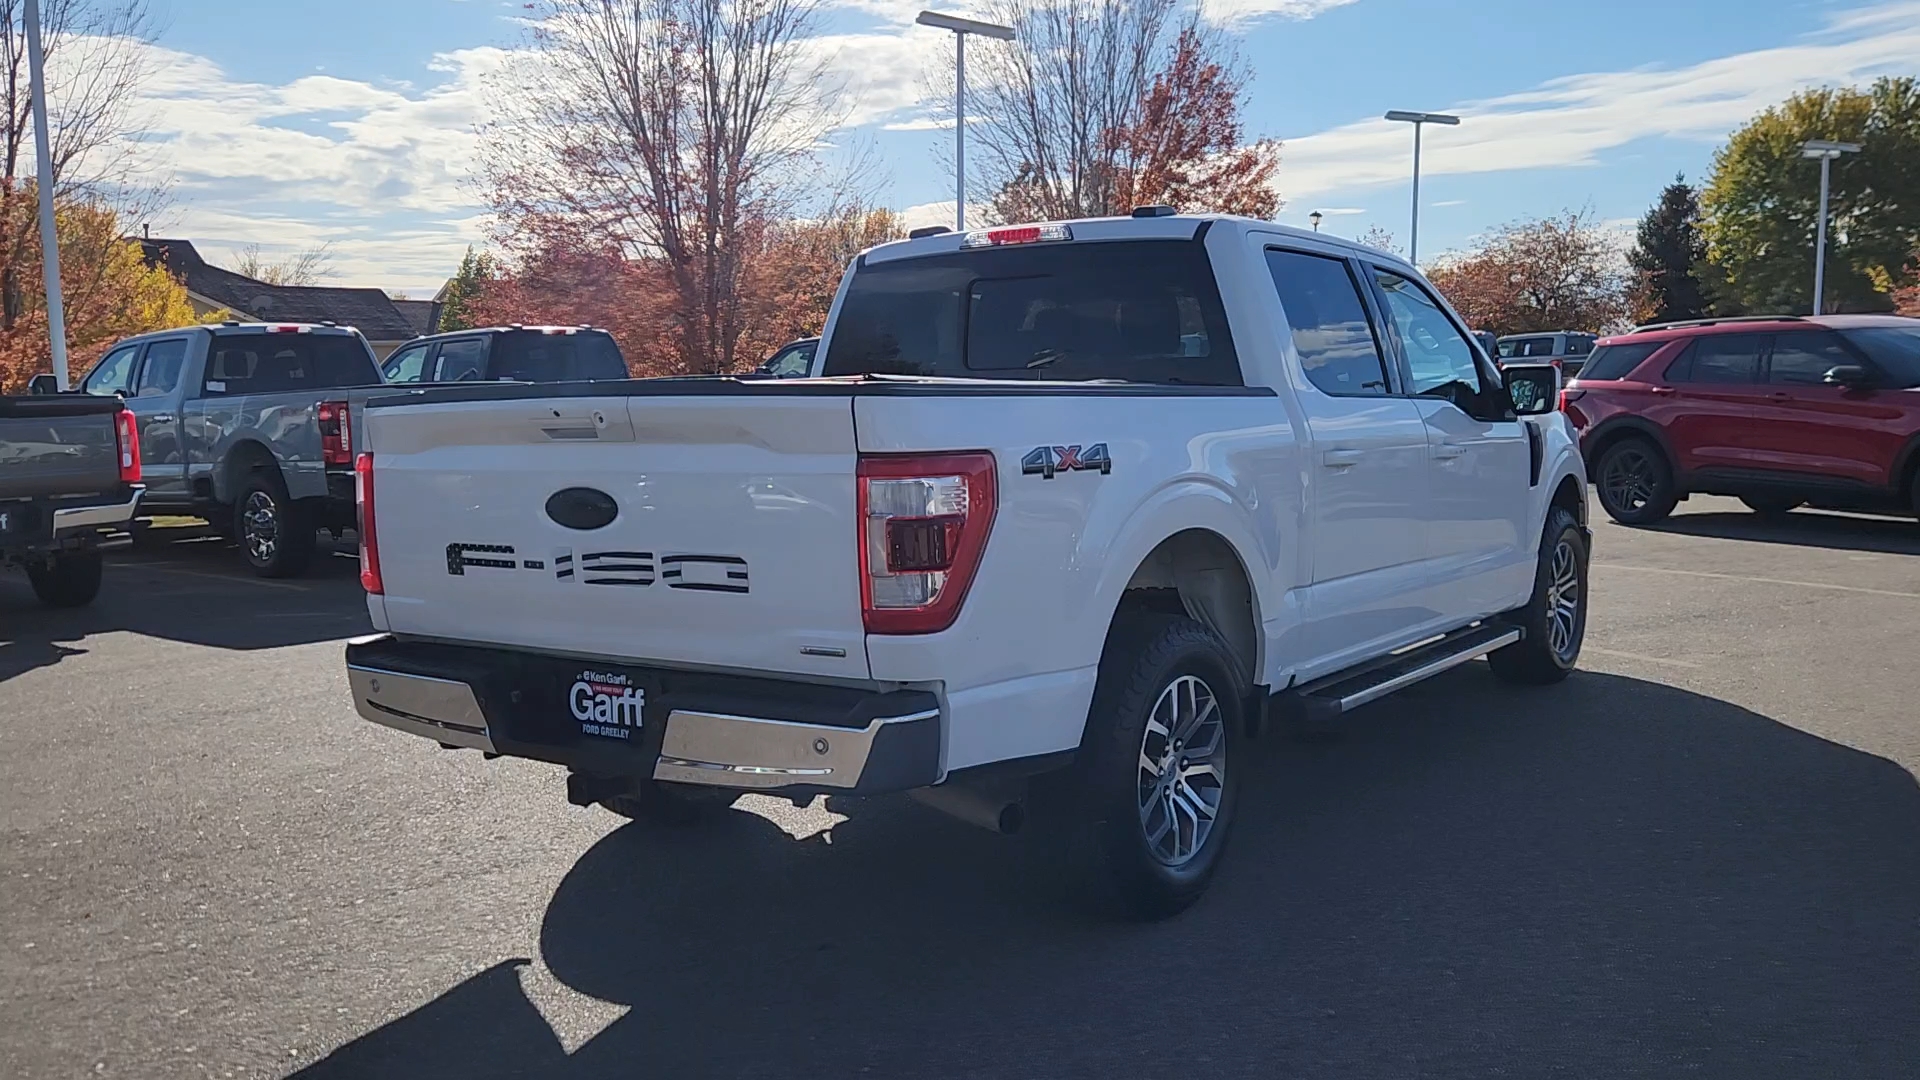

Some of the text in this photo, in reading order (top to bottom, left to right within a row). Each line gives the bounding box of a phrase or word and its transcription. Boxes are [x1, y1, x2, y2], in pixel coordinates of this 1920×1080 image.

[591, 671, 606, 683] Ken
[570, 681, 645, 727] Garff
[582, 723, 630, 739] FORD GREELEY
